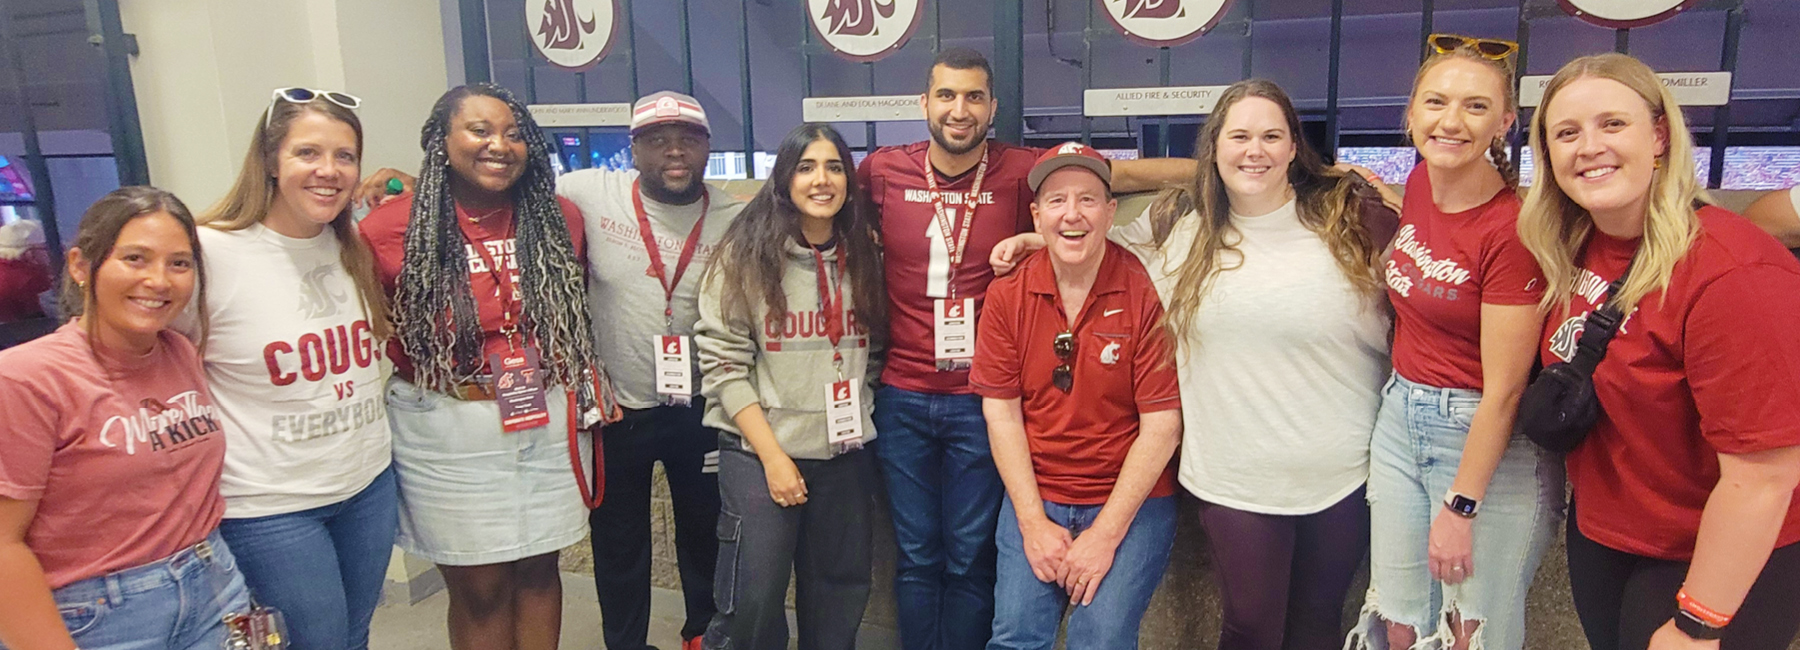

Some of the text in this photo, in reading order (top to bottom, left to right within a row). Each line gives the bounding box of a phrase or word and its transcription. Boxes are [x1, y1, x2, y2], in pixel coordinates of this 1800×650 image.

[841, 100, 857, 108] AND
[879, 98, 919, 107] HAGADONE
[1115, 92, 1142, 100] ALLIED
[1145, 91, 1160, 99] FIRE
[1172, 90, 1212, 98] SECURITY
[925, 207, 956, 297] 1
[333, 380, 354, 401] VS
[149, 430, 167, 452] A
[164, 413, 220, 445] KICK
